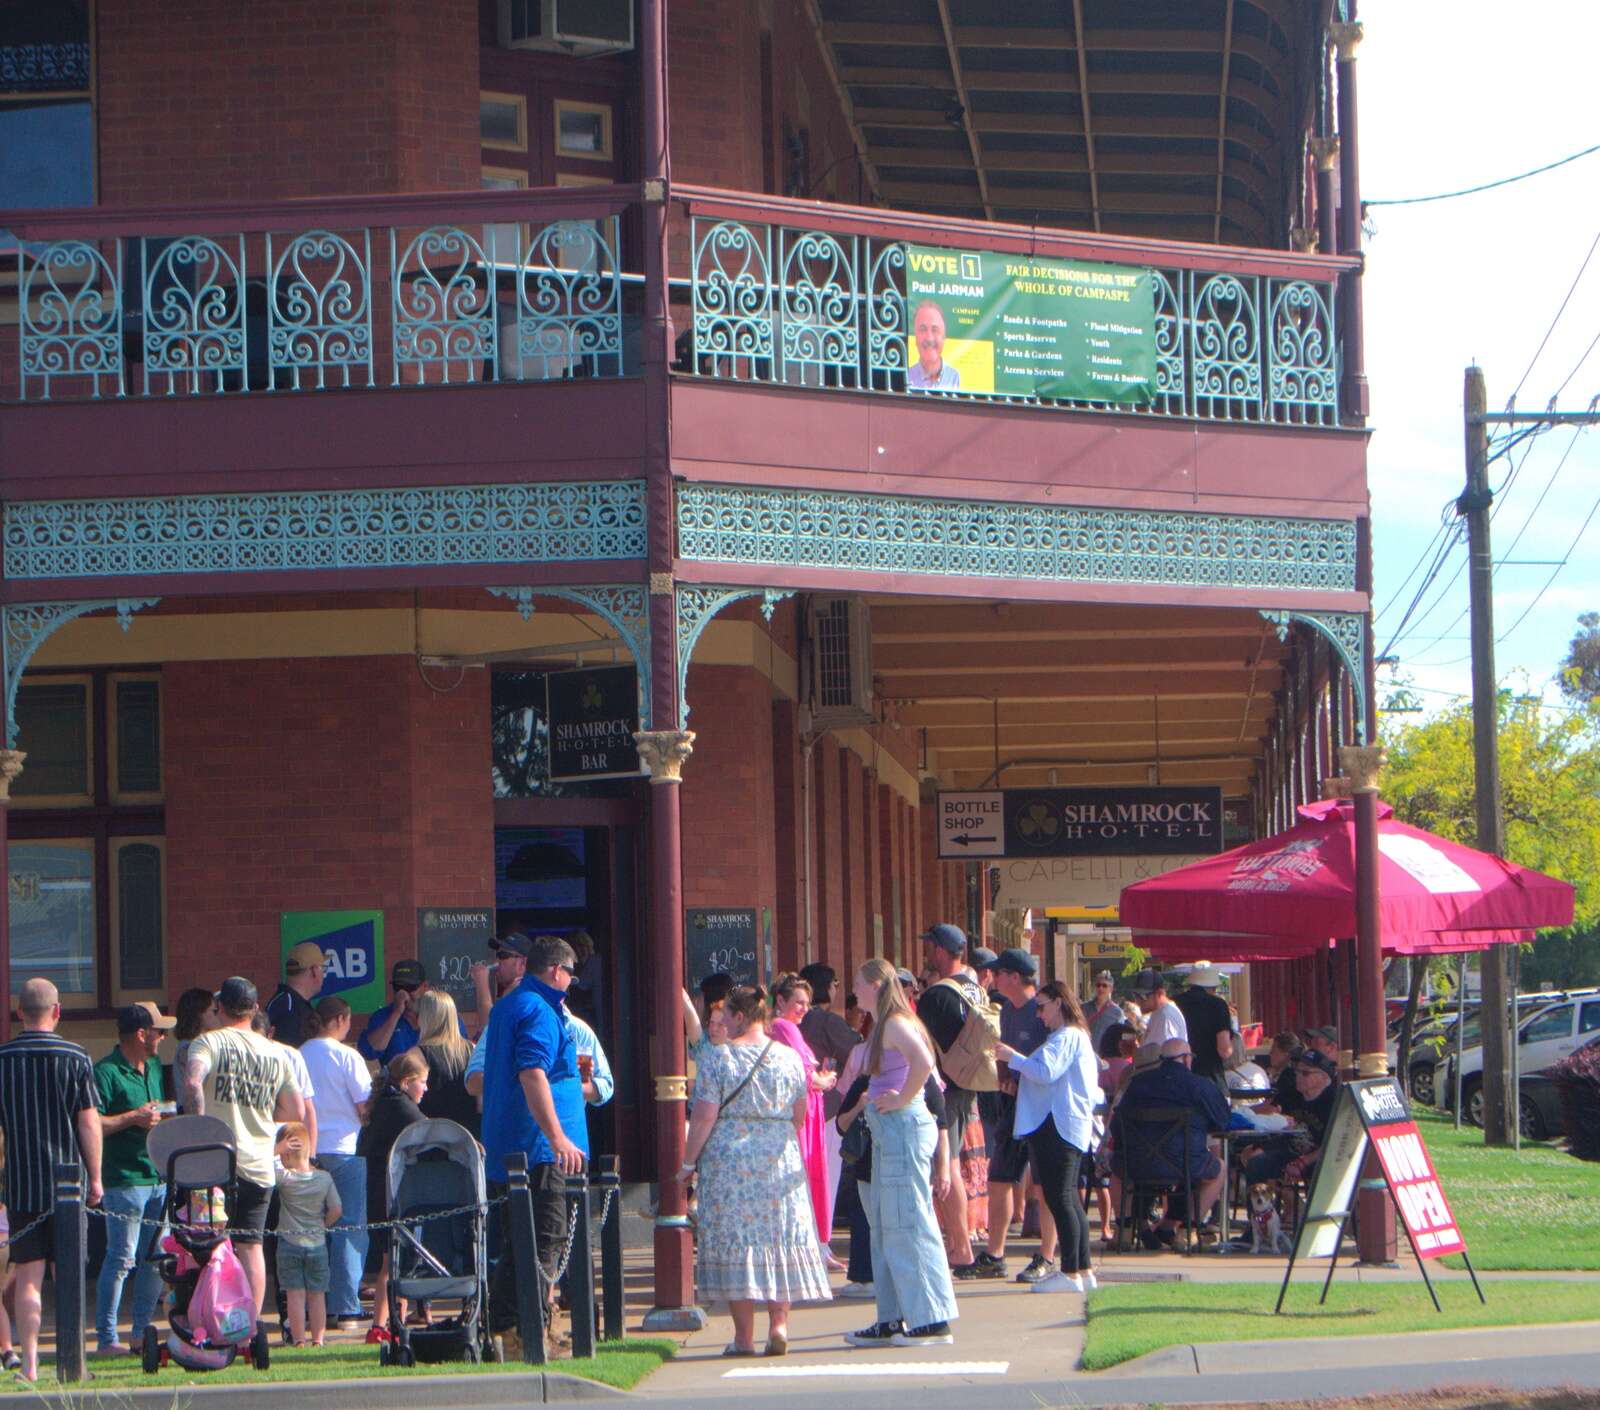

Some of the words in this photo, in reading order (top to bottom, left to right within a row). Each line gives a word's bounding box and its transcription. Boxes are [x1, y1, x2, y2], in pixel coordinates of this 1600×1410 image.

[908, 253, 958, 275] VOTE
[1005, 264, 1030, 277] FAIR
[1033, 266, 1090, 283] DECISIONS
[1091, 271, 1114, 286] FOR
[1115, 275, 1137, 288] THE
[912, 281, 935, 295] Paul
[938, 283, 984, 298] JARMAN
[1014, 280, 1056, 296] WHOLE
[1058, 284, 1072, 297] OF
[1074, 286, 1130, 303] CAMPASPE
[1003, 314, 1024, 325] Roads
[1024, 316, 1031, 326] &
[1032, 317, 1068, 329] Footpaths
[1003, 331, 1025, 343] Sports
[1025, 333, 1057, 344] Reserves
[1003, 348, 1023, 358] Parks
[1024, 349, 1031, 359] &
[1031, 351, 1063, 361] Gardens
[1003, 365, 1026, 375] Access
[1026, 367, 1034, 376] to
[1033, 367, 1065, 377] Services
[556, 719, 631, 740] SHAMROCK
[581, 752, 608, 770] BAR
[944, 801, 1001, 814] BOTTLE
[1064, 802, 1212, 824] SHAMROCK
[944, 817, 985, 830] SHOP
[1009, 857, 1123, 883] CAPELLI
[1134, 859, 1152, 878] &
[440, 912, 488, 923] SHAMROCK
[706, 913, 752, 923] SHAMROCK
[1098, 943, 1125, 953] Betta
[323, 948, 368, 979] AB
[1375, 1093, 1403, 1111] HOTEL
[1376, 1133, 1431, 1183] NOW
[1396, 1180, 1453, 1232] OPEN
